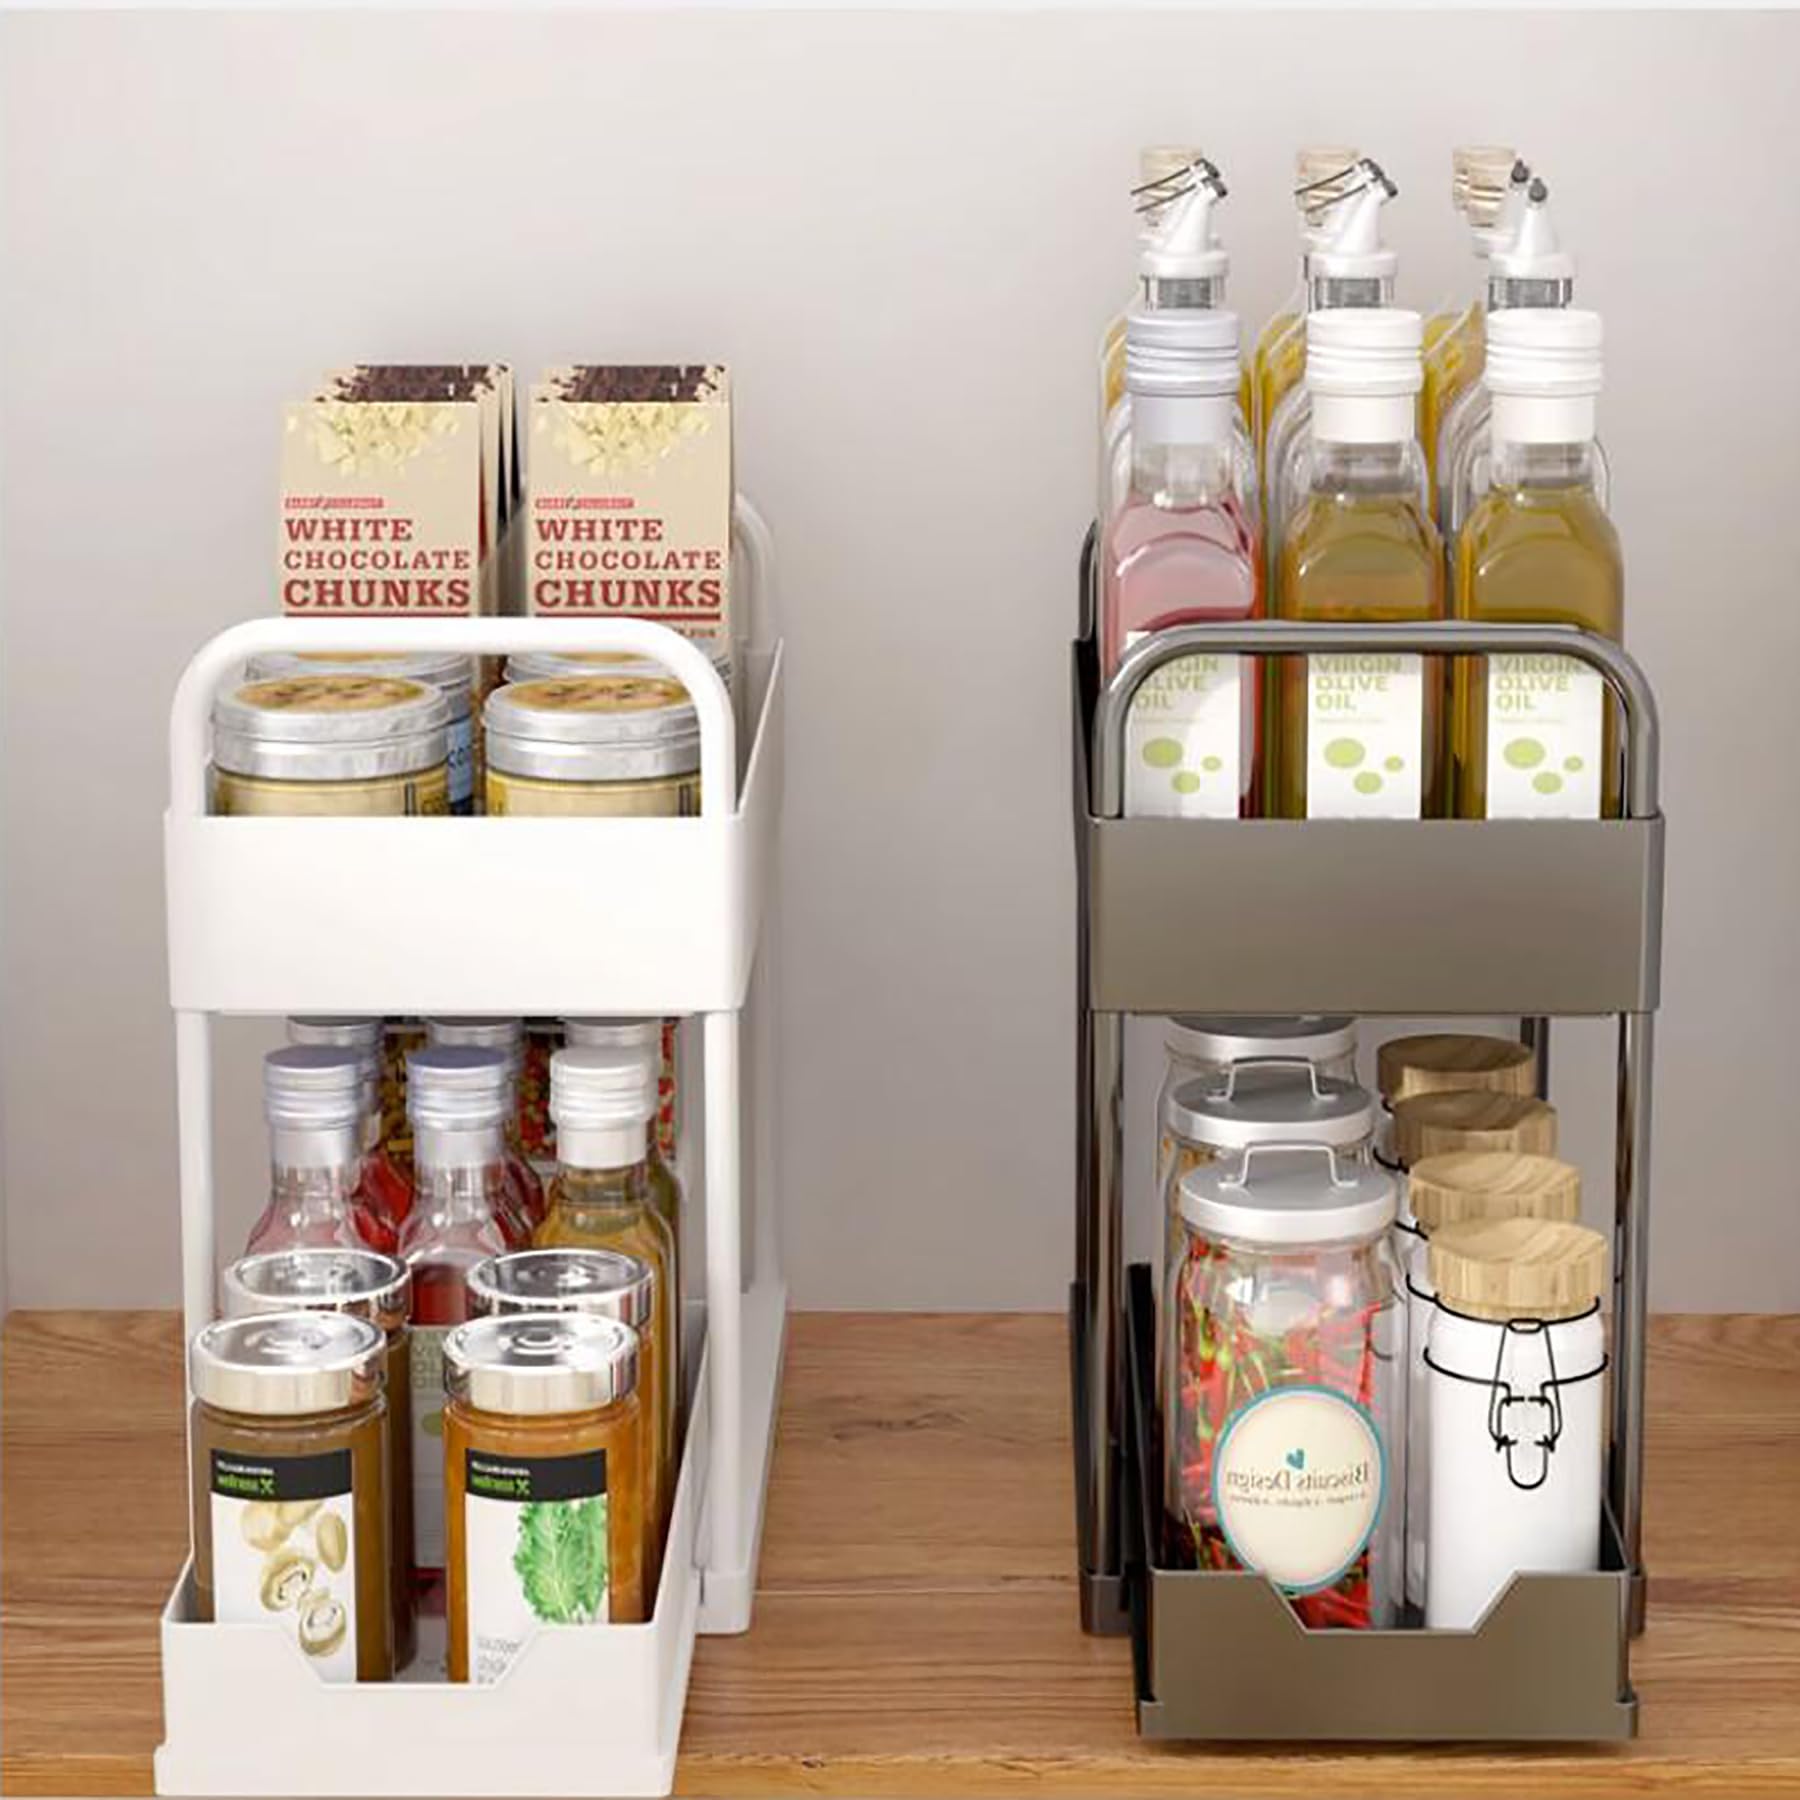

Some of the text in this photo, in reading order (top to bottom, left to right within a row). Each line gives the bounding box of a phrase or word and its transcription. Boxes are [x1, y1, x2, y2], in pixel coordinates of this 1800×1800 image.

[285, 519, 413, 541] WHITE
[535, 519, 663, 541] WHITE
[284, 550, 470, 570] CHOCOLATE
[535, 550, 721, 570] CHOCOLATE
[284, 579, 470, 607] CHUNKS
[535, 579, 721, 607] CHUNKS
[1315, 675, 1389, 692] OLIVE
[1496, 675, 1569, 692] OLIVE
[1315, 694, 1357, 710] OIL
[1497, 694, 1538, 710] OIL
